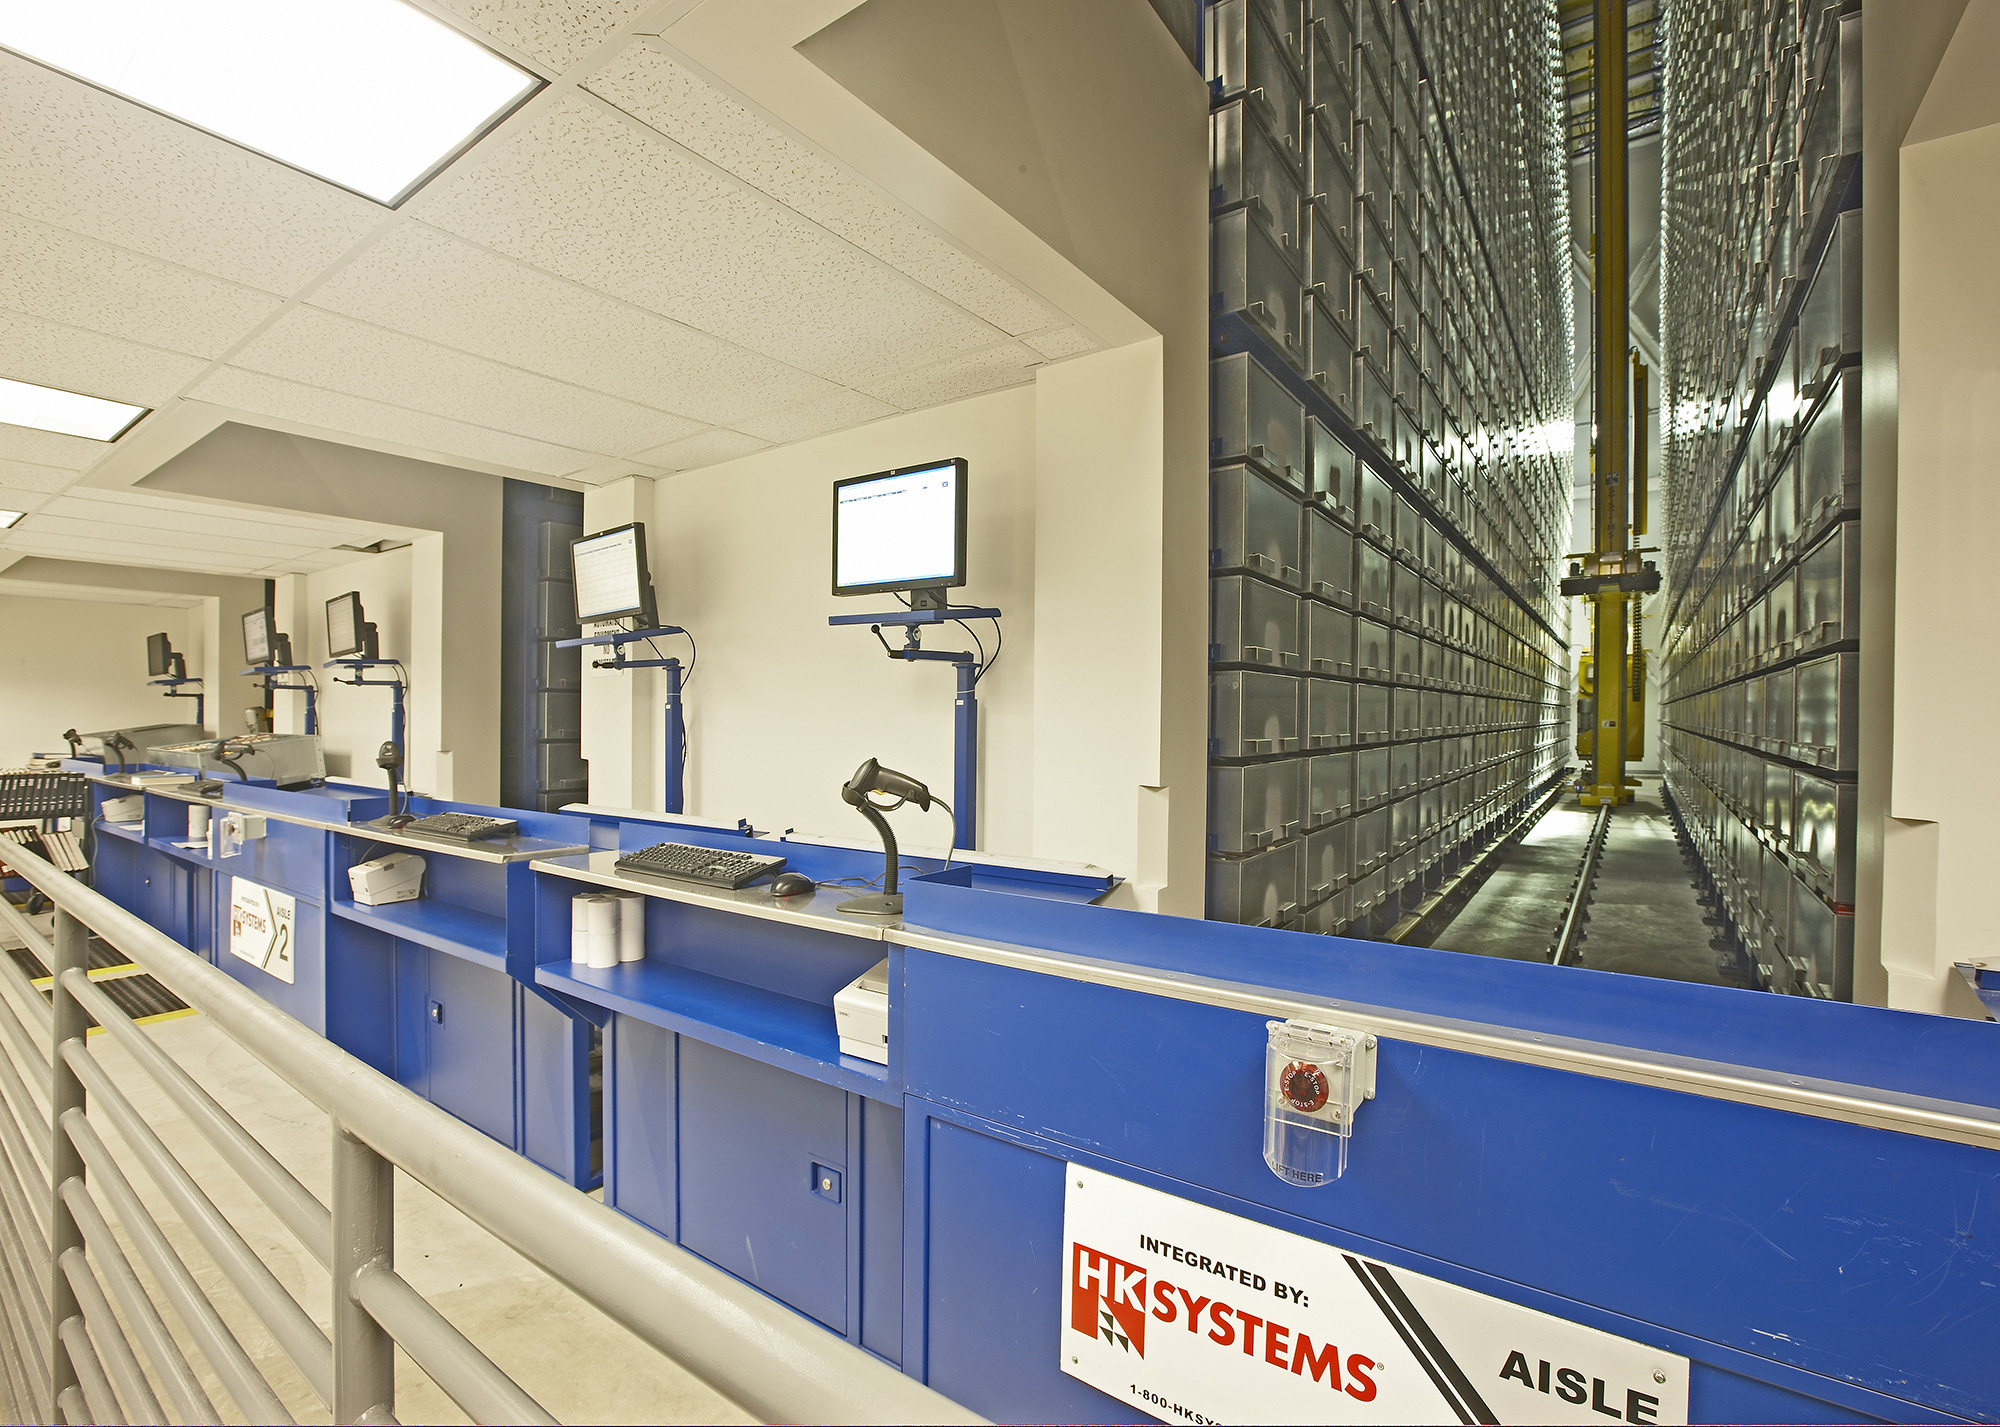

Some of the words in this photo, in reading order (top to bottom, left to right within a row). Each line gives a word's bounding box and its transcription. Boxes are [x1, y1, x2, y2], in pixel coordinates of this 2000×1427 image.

[279, 923, 289, 962] 2
[1284, 1070, 1297, 1092] E-STOP
[1304, 1072, 1321, 1095] E-STOP
[1290, 1098, 1315, 1108] E-STOP
[1271, 1160, 1290, 1176] LIFT
[1292, 1169, 1323, 1183] HERE
[1140, 1233, 1267, 1292] INTEGRATED
[1274, 1281, 1310, 1308] BY:
[1071, 1241, 1147, 1316] HK
[1151, 1279, 1378, 1403] SYSTEMS
[1130, 1384, 1223, 1426] 1-800-HKSY
[1498, 1350, 1660, 1426] AISLE
